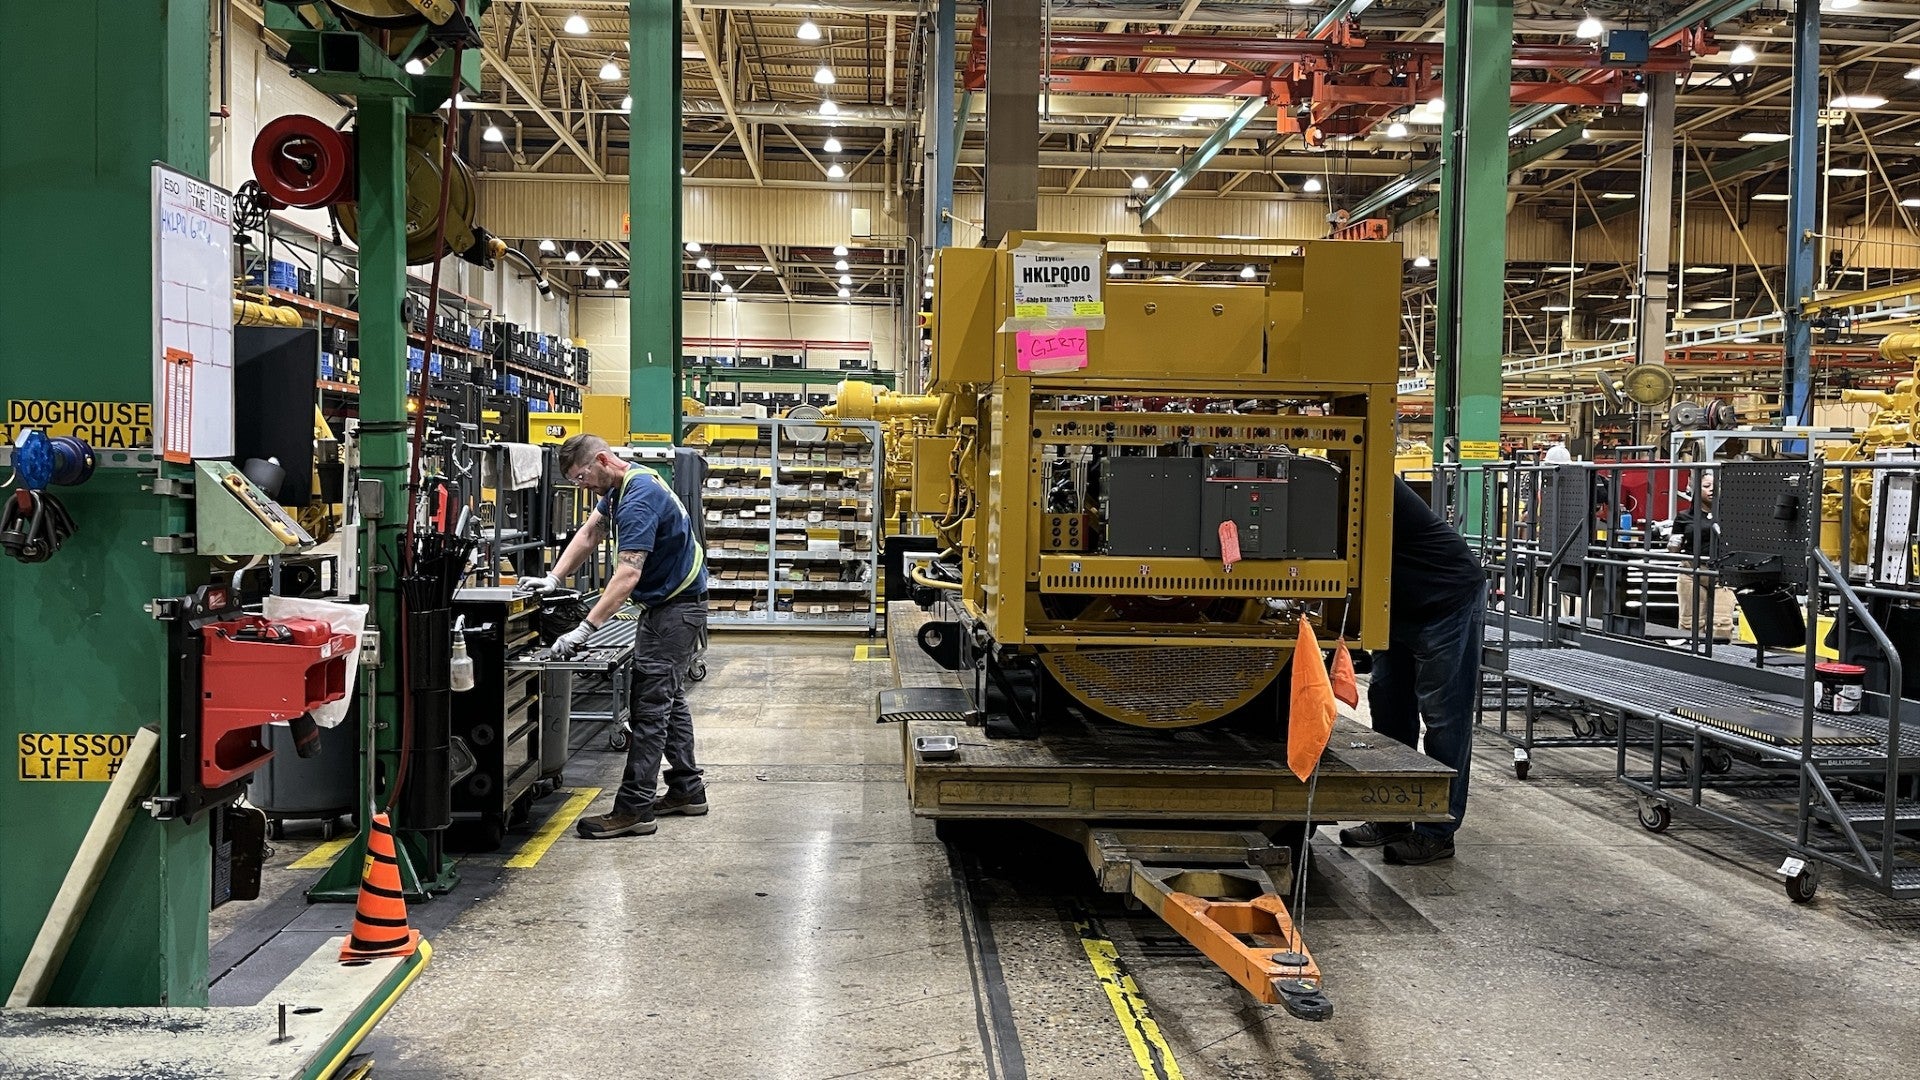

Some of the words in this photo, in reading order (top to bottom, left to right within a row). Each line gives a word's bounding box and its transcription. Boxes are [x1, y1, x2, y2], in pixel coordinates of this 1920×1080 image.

[164, 178, 179, 195] ESO
[187, 181, 209, 200] START
[191, 195, 206, 211] TIME
[11, 400, 150, 426] DOGHOUSE
[546, 425, 562, 436] CAT
[21, 757, 89, 779] LIFT
[1361, 783, 1426, 807] 2024
